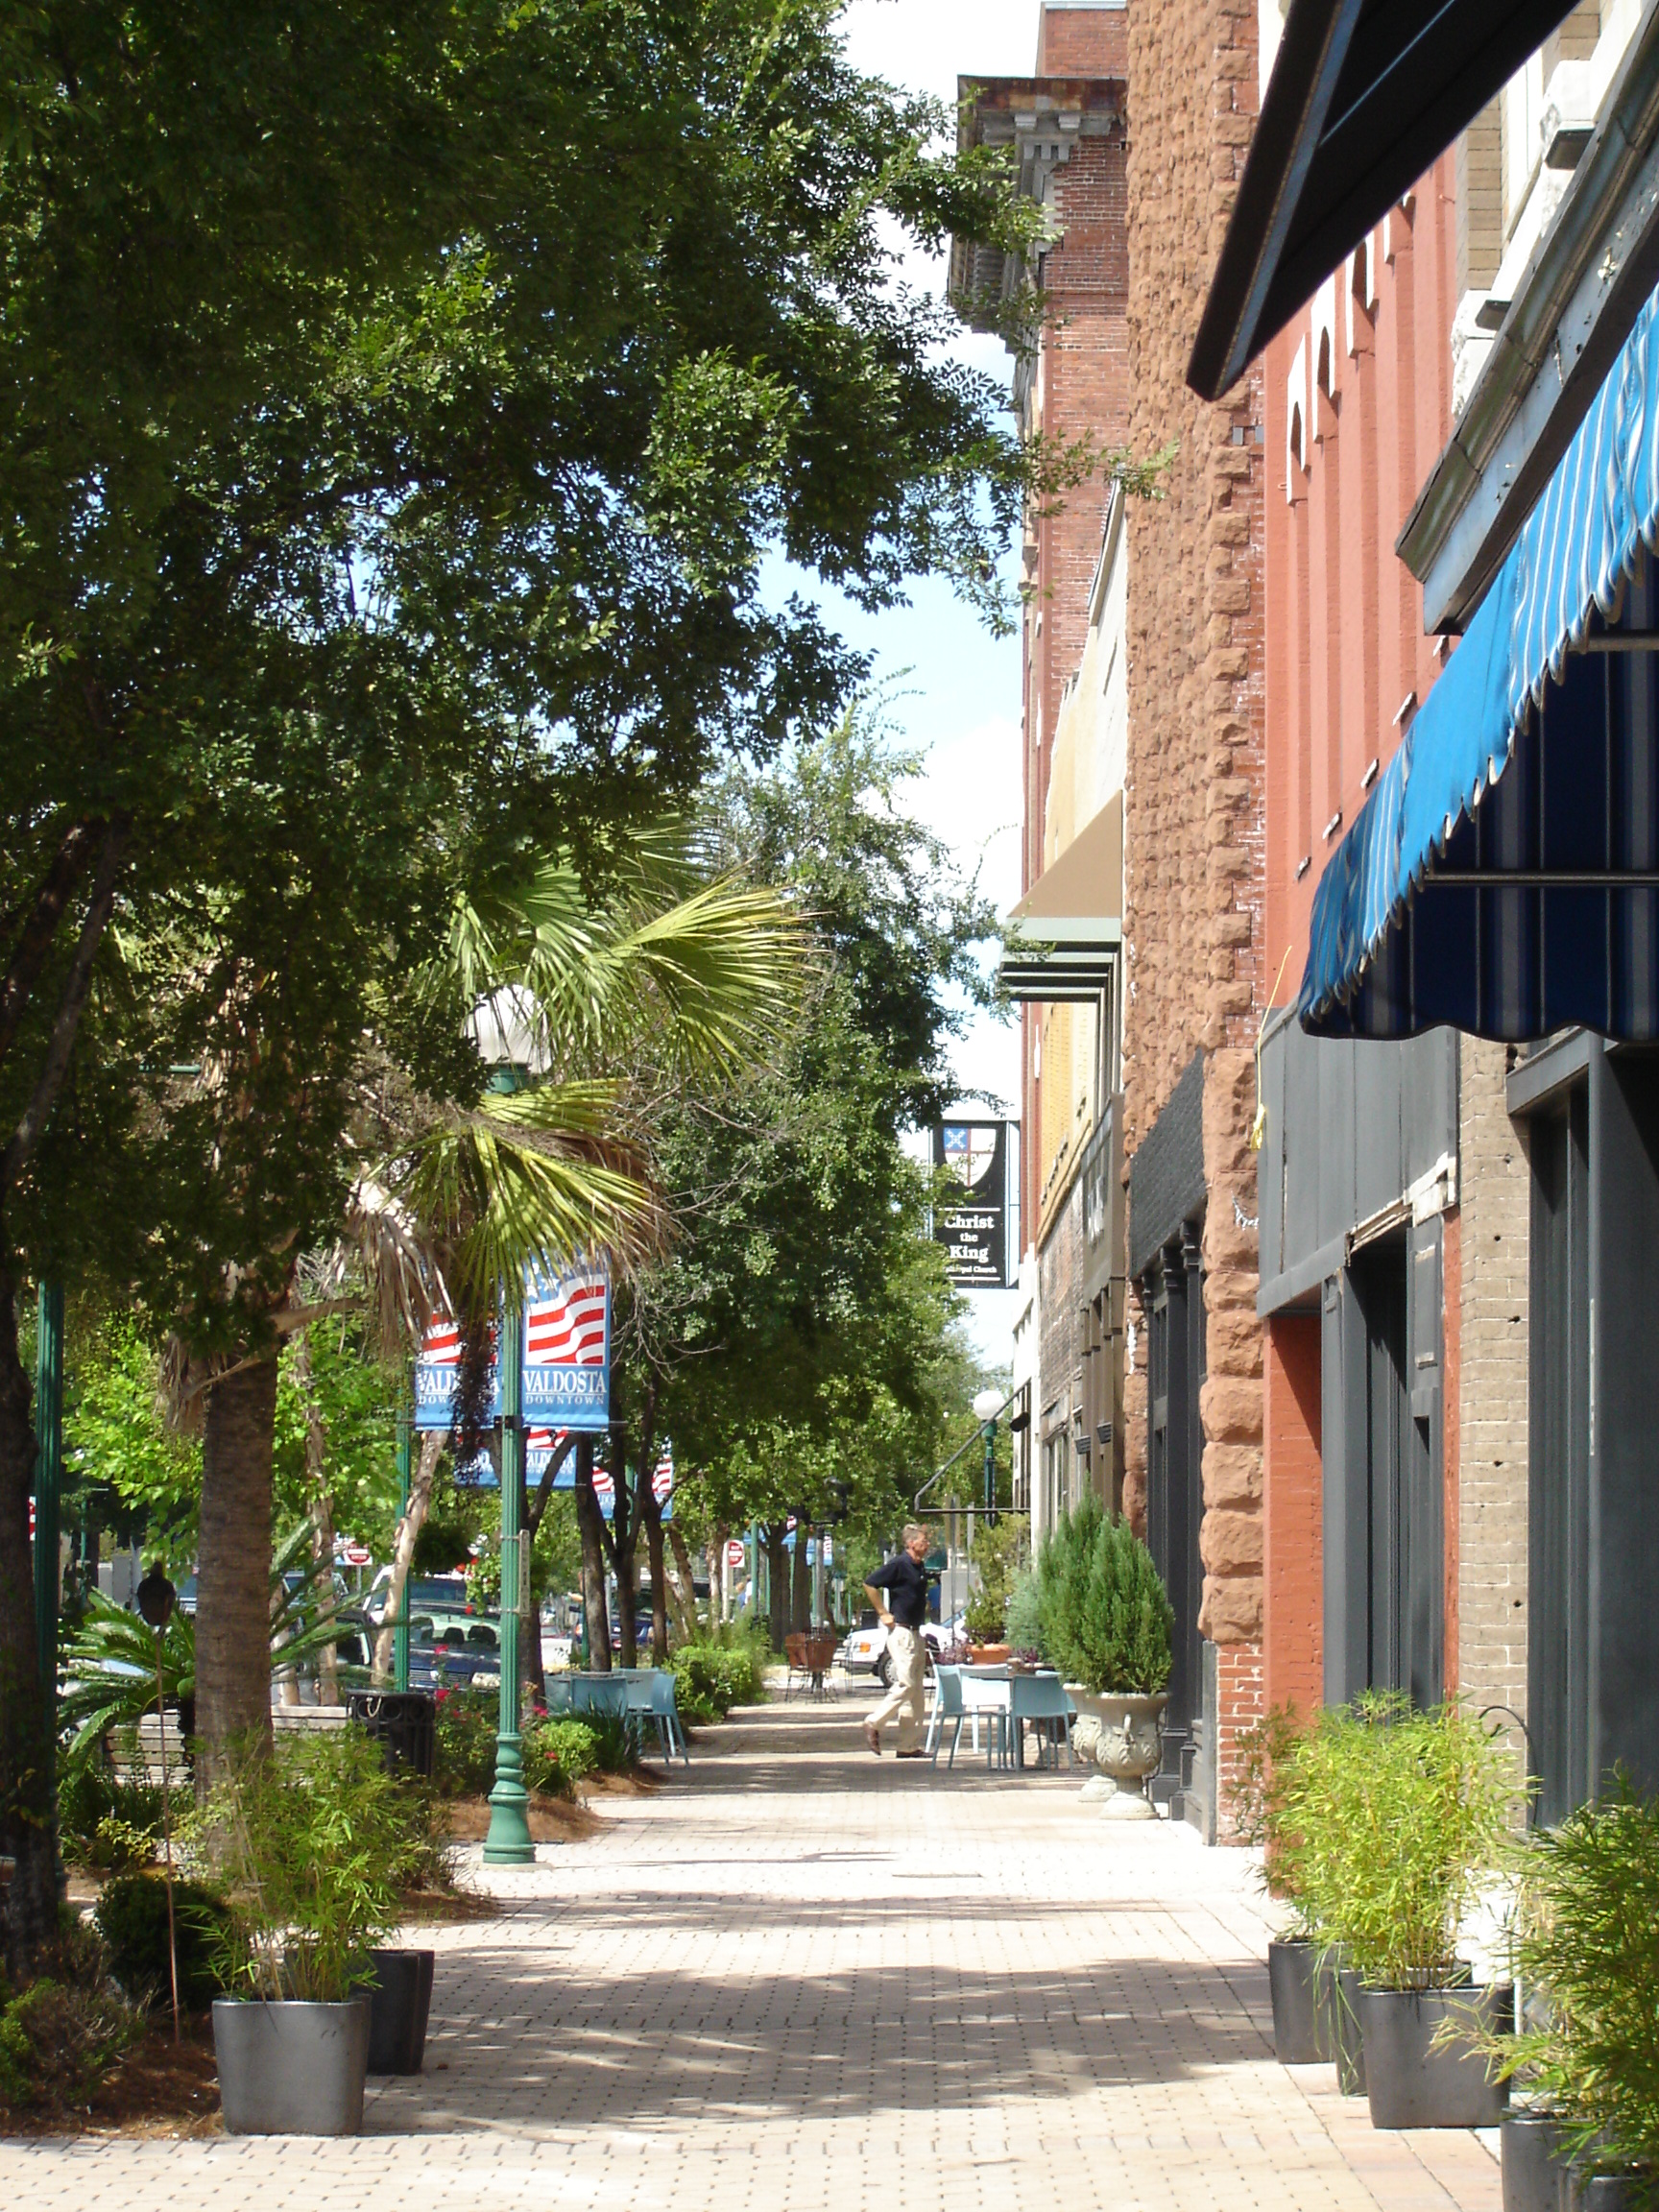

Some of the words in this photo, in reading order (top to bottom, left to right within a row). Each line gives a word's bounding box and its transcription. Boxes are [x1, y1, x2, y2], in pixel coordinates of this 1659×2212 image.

[944, 1214, 995, 1229] Christ
[960, 1232, 978, 1242] the
[949, 1244, 989, 1263] King
[417, 1370, 500, 1392] VALDA
[522, 1370, 607, 1393] VALDOSTA
[525, 1395, 605, 1405] DOWNTOWN
